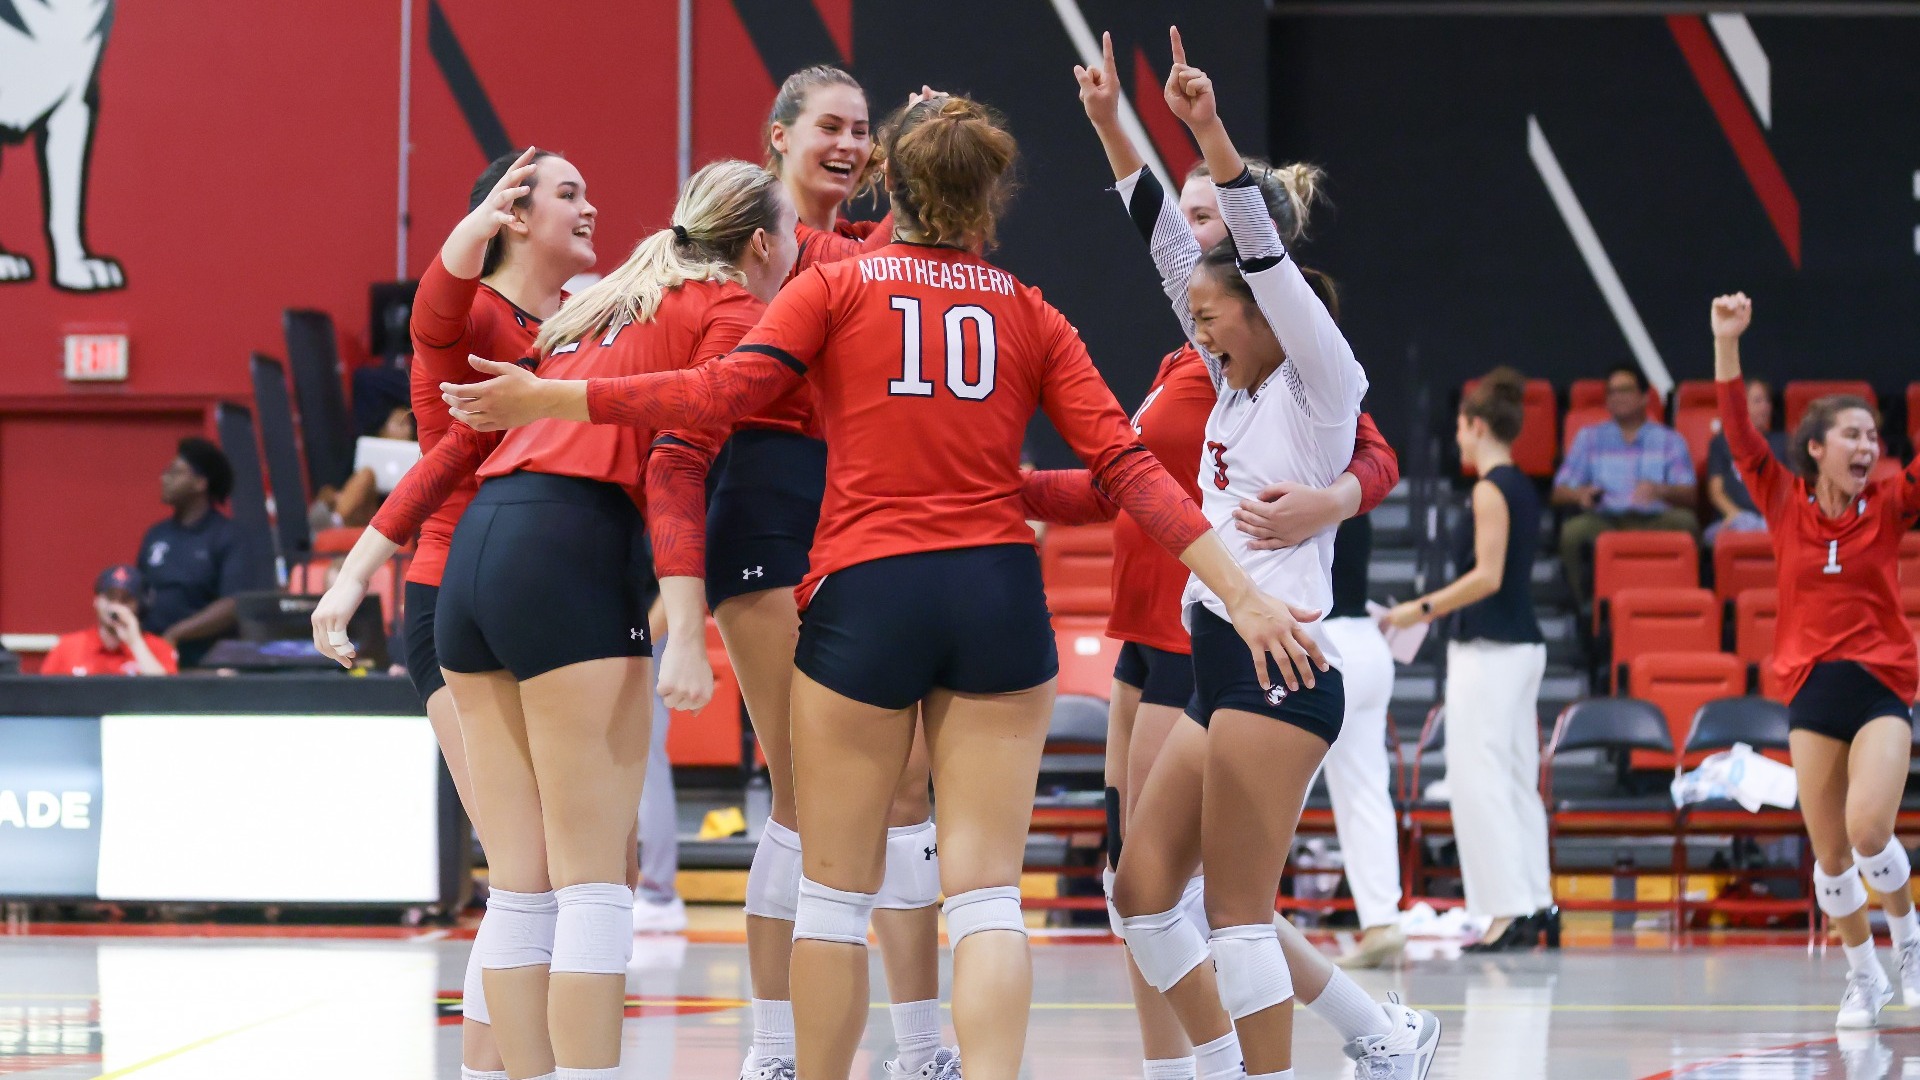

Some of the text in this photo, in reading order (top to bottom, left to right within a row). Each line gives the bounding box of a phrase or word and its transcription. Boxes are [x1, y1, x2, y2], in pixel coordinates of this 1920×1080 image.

[858, 256, 1016, 297] NORTHEASTERN
[887, 294, 998, 402] 10
[1206, 440, 1230, 491] 3
[1822, 538, 1843, 574] 1
[0, 789, 92, 829] ADE
